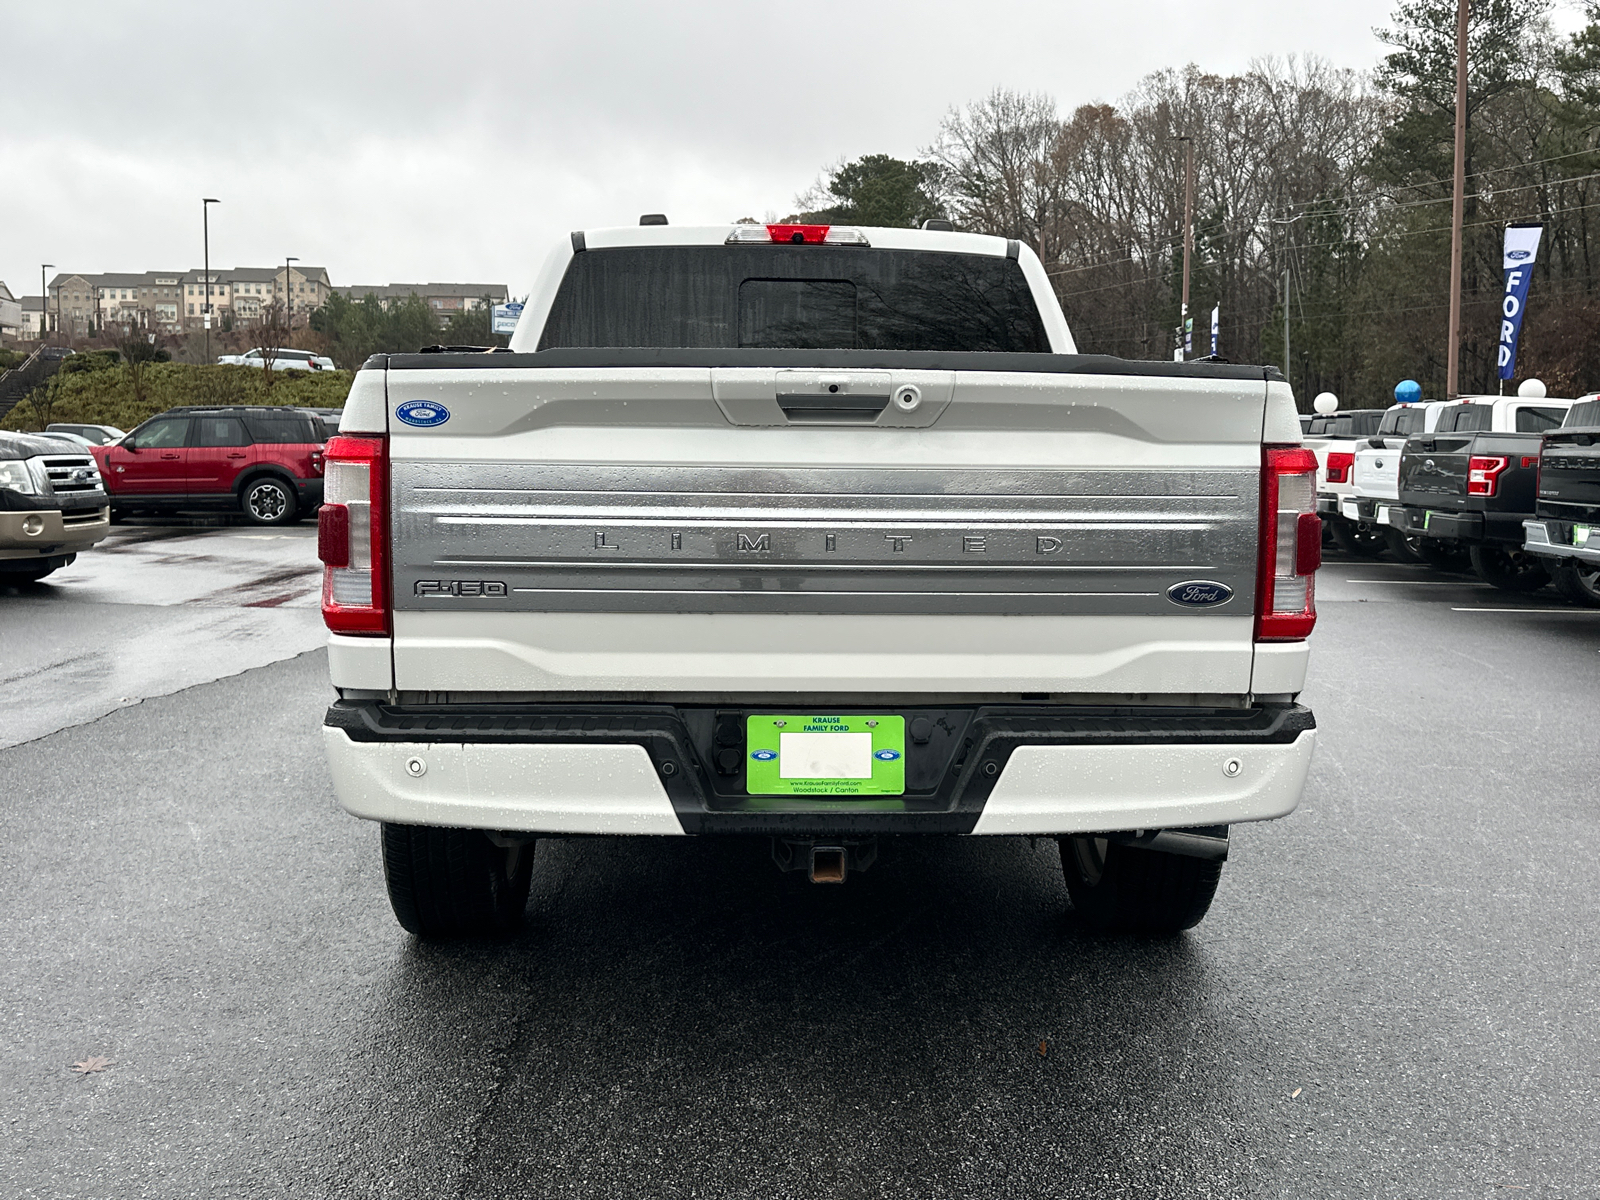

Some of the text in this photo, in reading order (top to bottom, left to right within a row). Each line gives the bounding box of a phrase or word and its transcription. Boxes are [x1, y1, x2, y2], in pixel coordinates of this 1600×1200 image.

[1498, 272, 1522, 367] FORD
[403, 403, 442, 411] KRAUSE FAMILY
[595, 531, 1064, 554] LIMITED
[414, 580, 507, 597] F-150
[1182, 585, 1219, 601] Ford
